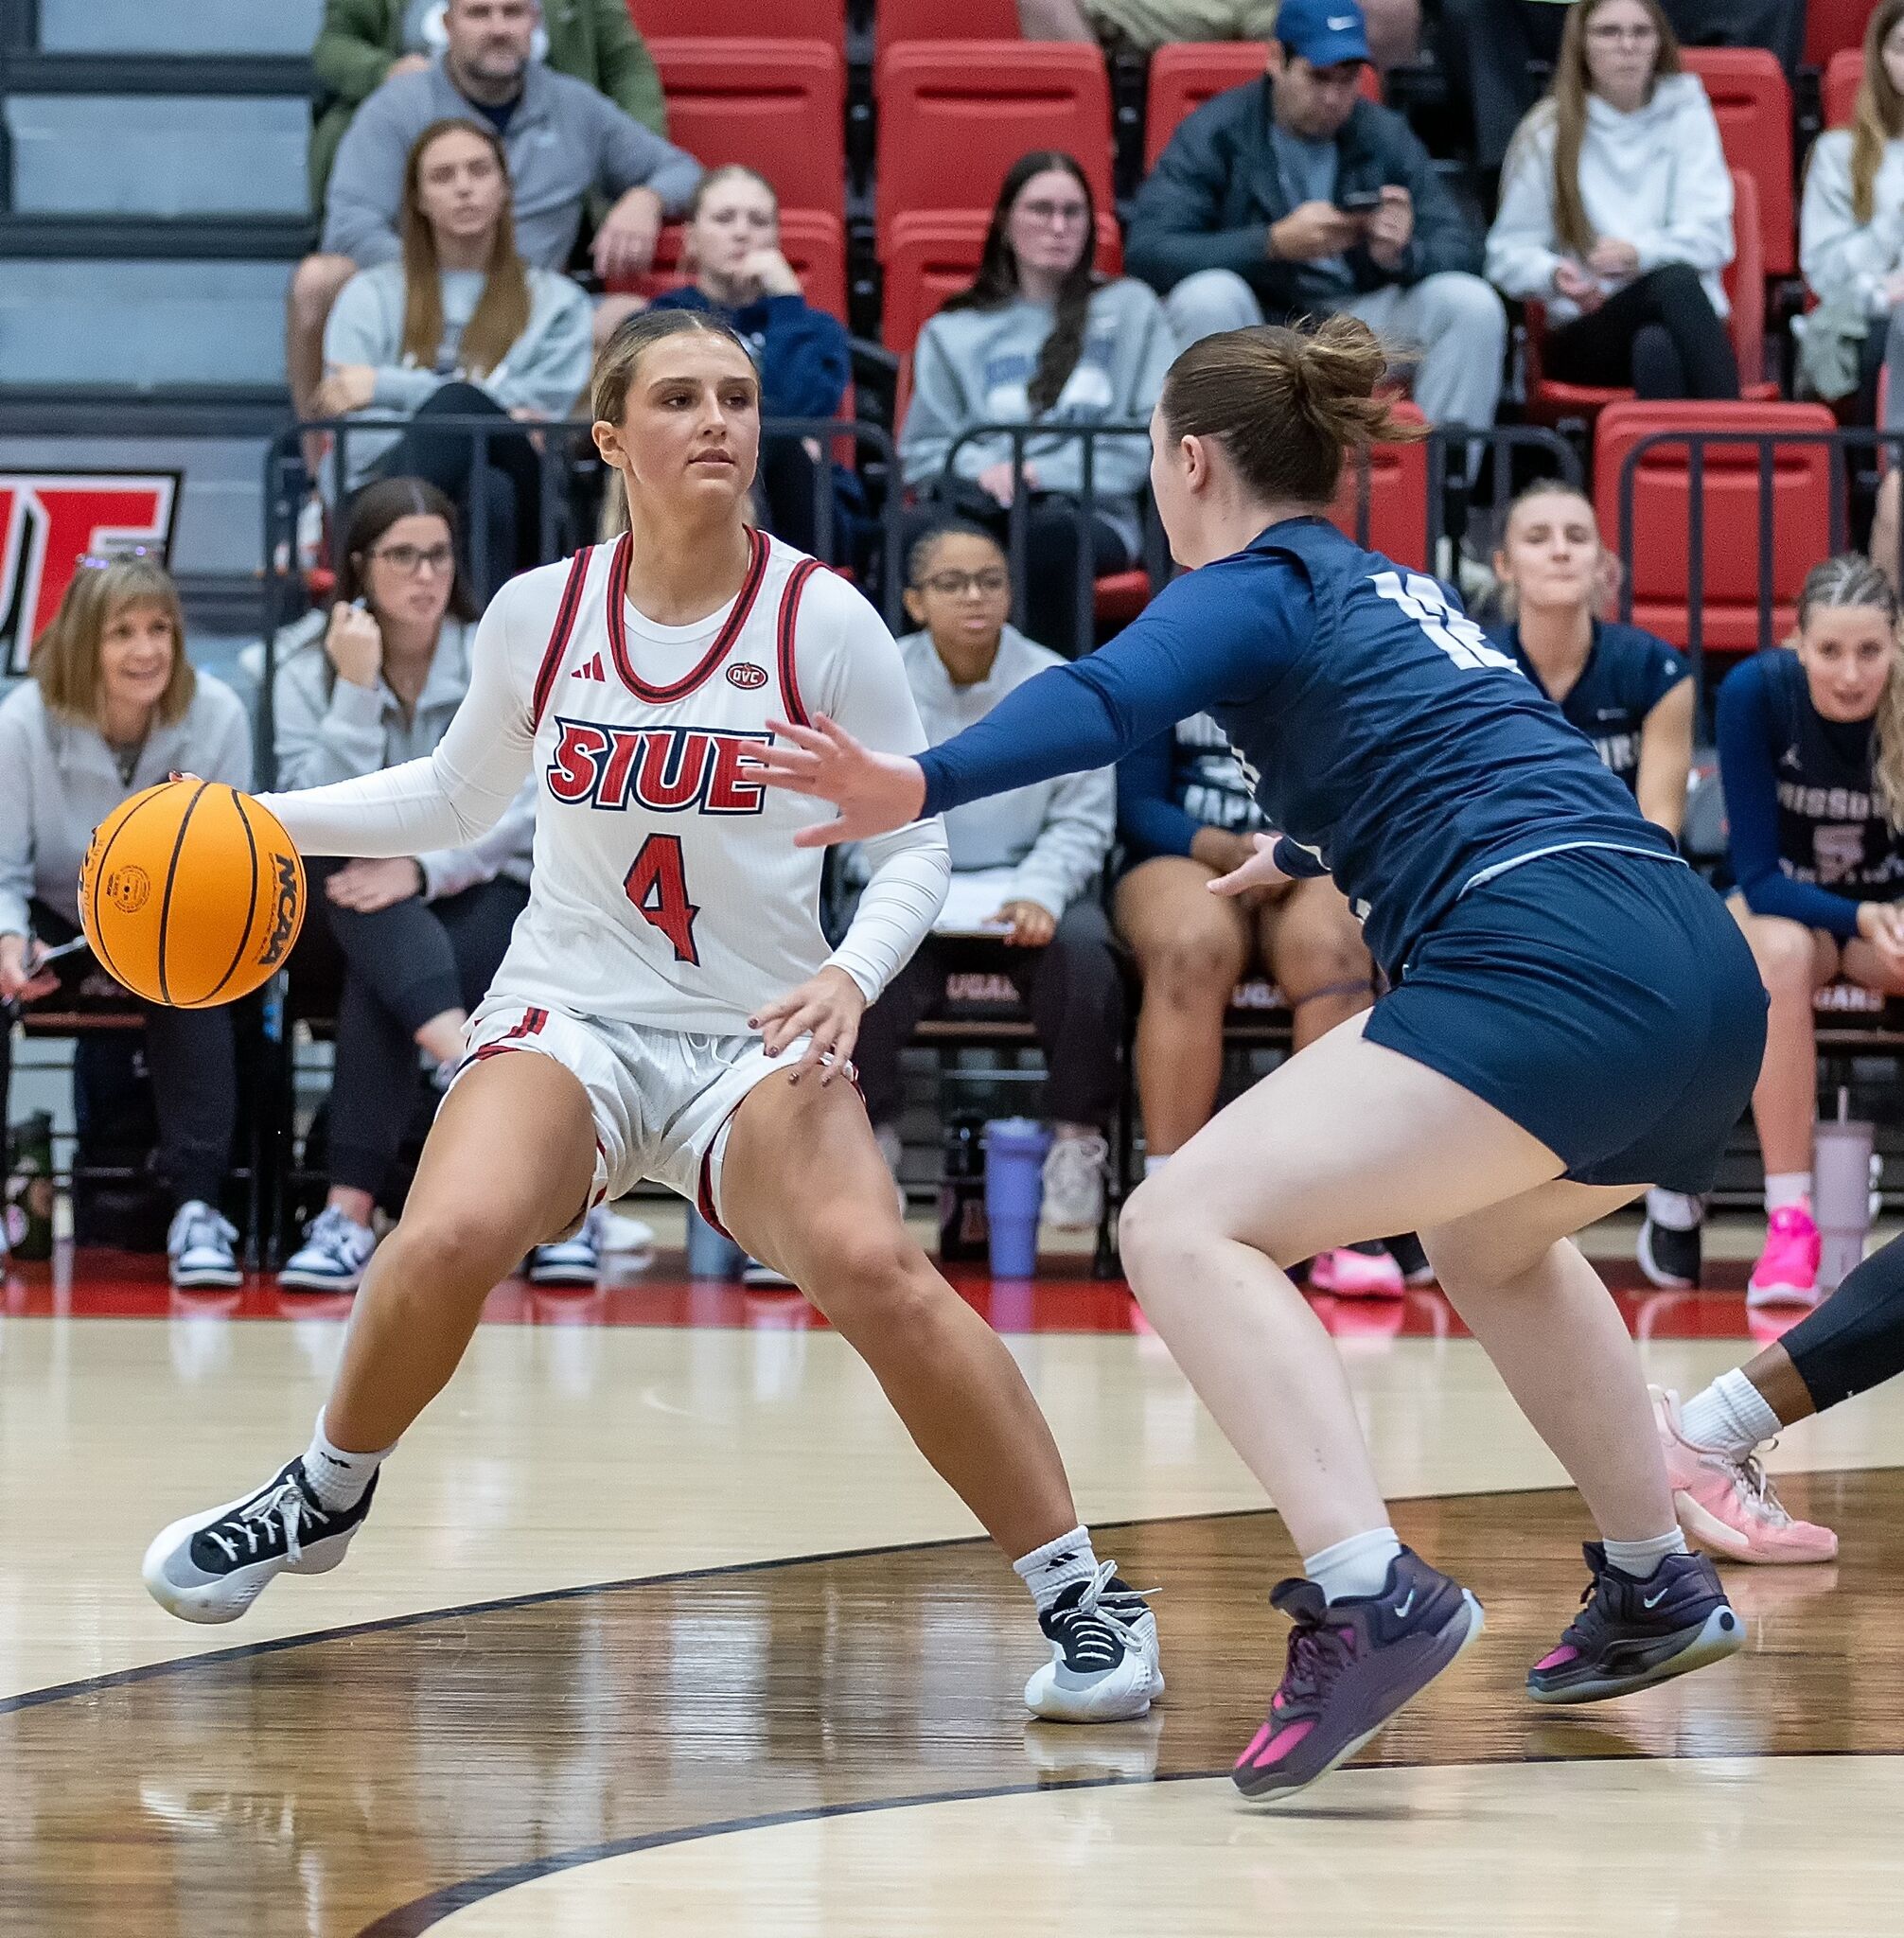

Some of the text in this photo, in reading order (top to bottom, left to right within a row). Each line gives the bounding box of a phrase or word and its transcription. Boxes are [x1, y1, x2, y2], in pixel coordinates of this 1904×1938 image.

[732, 668, 761, 683] OVC
[546, 714, 776, 816] SIUE
[257, 853, 297, 966] NCAA
[623, 833, 701, 968] 4
